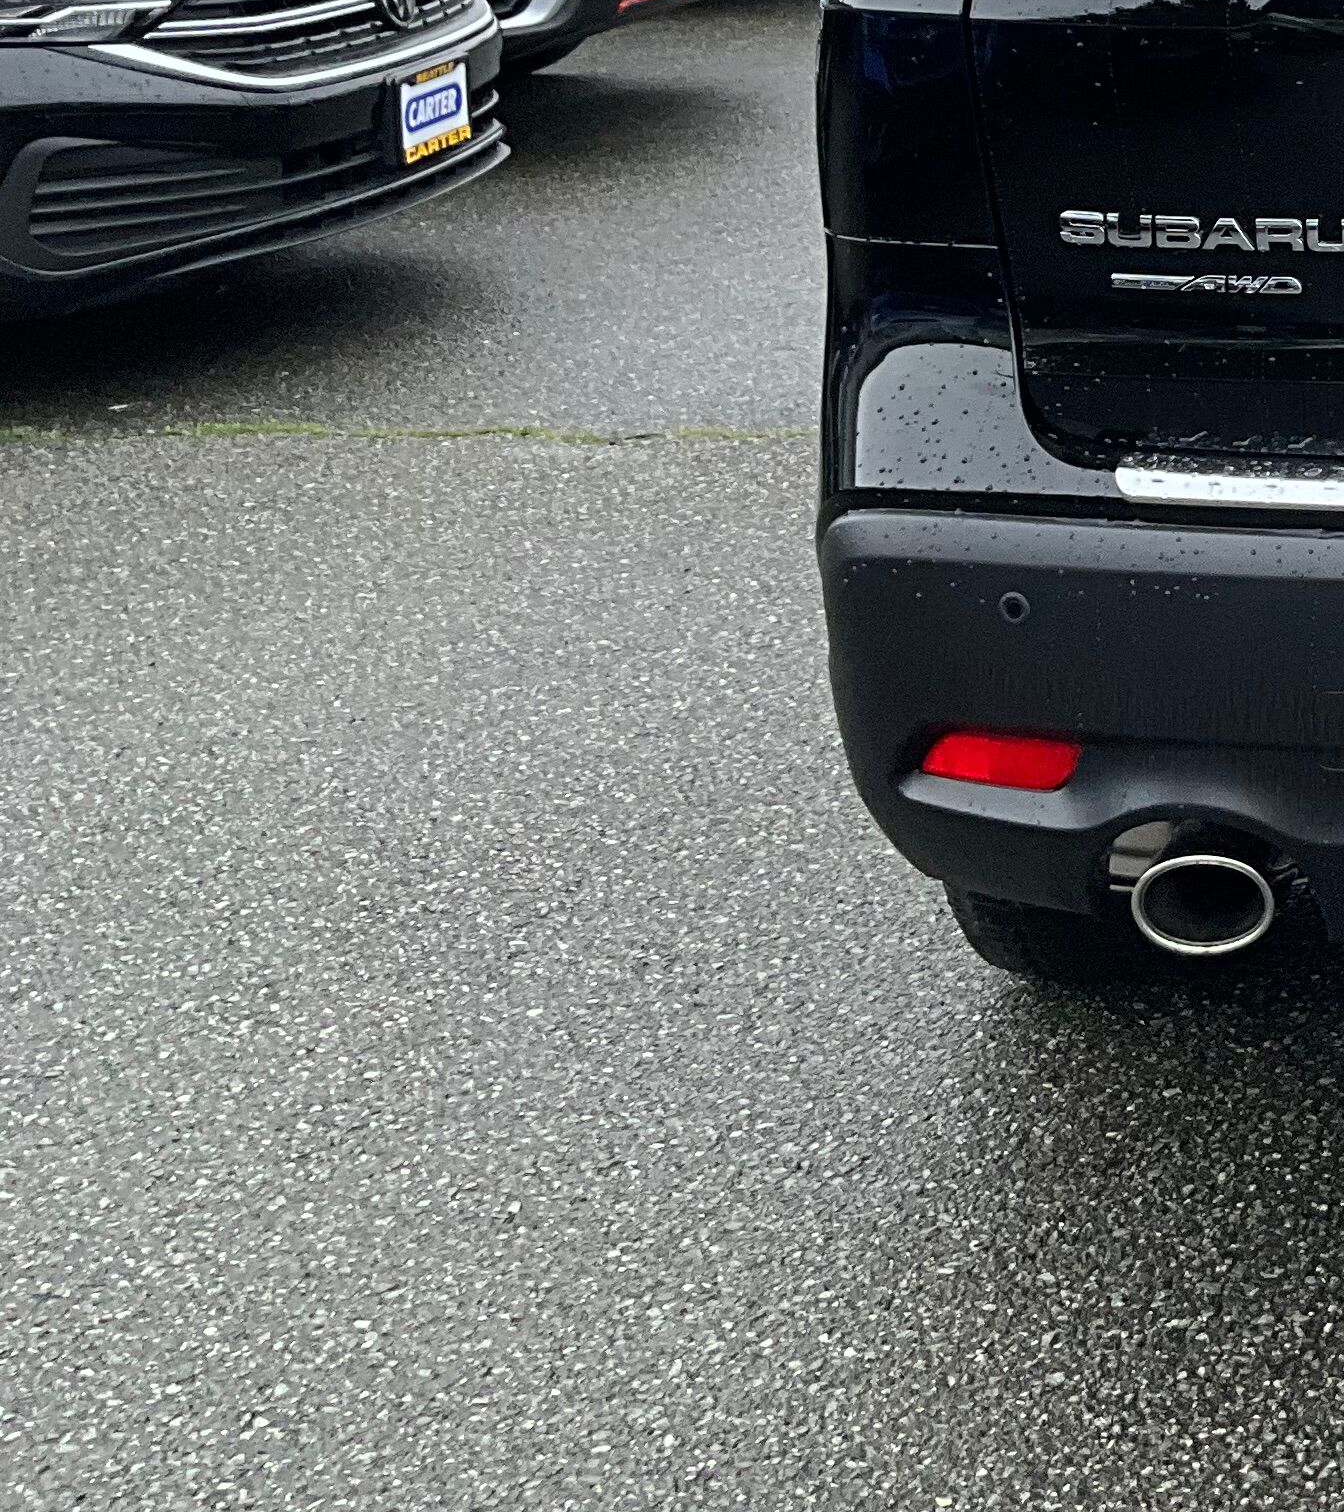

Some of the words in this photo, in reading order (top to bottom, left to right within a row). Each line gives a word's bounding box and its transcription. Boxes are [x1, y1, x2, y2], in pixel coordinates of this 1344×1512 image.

[408, 88, 458, 128] CARTER
[405, 124, 472, 164] CARTER
[1181, 274, 1303, 295] AWD
